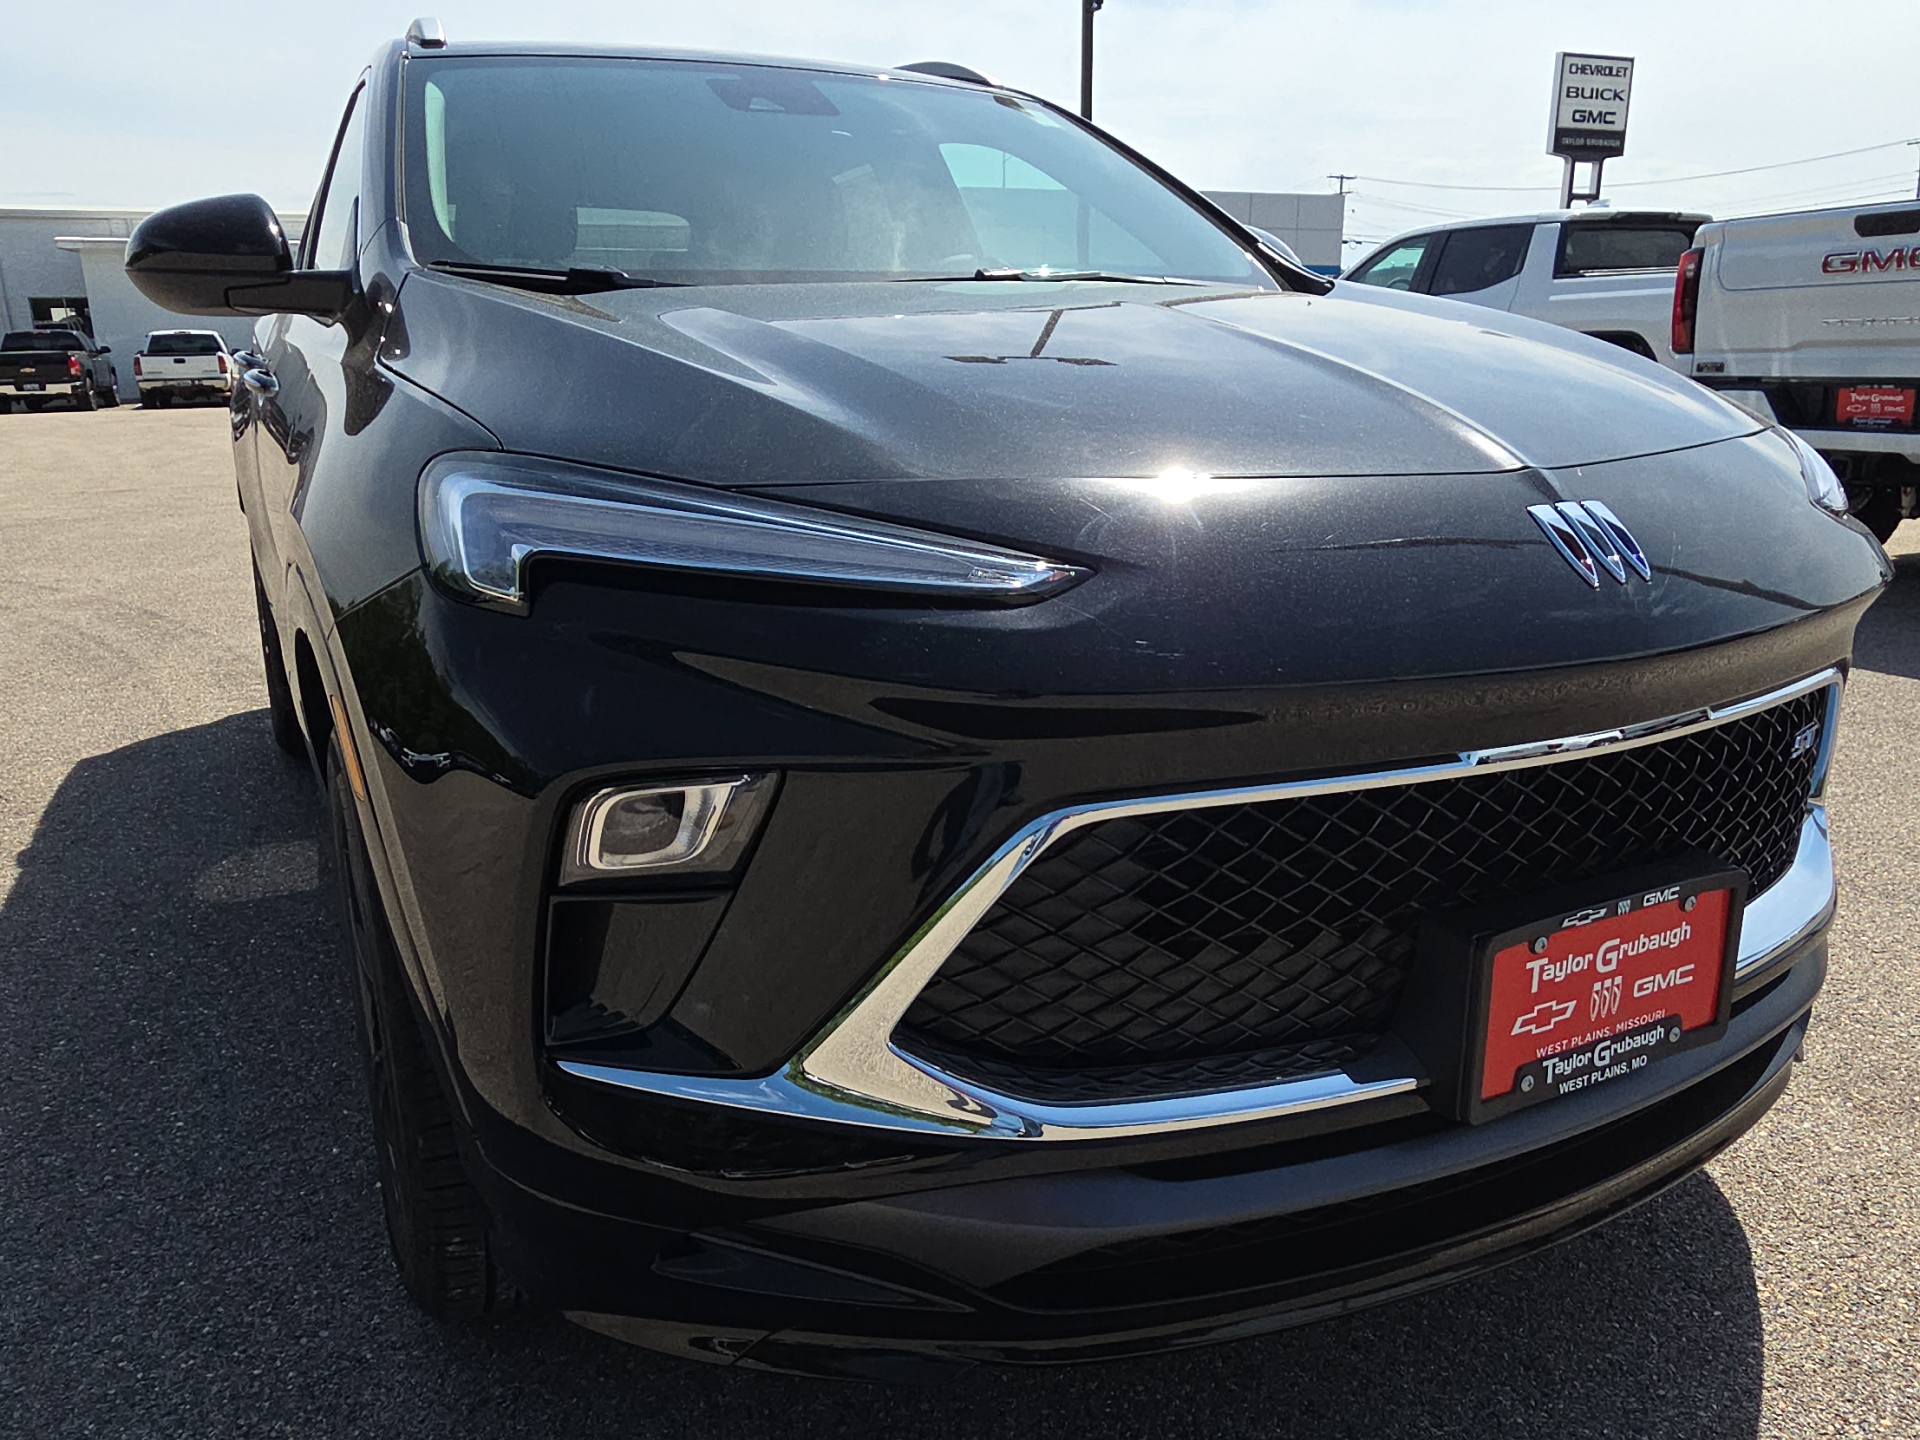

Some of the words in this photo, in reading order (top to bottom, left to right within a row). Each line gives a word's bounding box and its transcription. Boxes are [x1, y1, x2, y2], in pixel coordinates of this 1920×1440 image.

[1569, 63, 1628, 78] CHEVROLET
[1566, 86, 1625, 101] BUICK
[1572, 109, 1617, 124] GMC
[1643, 886, 1680, 907] GMC
[1526, 953, 1593, 993] Taylor
[1596, 921, 1691, 973] Grubaugh
[1633, 964, 1695, 997] GMC
[1536, 1040, 1568, 1058] WEST
[1615, 1009, 1665, 1034] MISSOURI
[1543, 1051, 1592, 1084] Taylor
[1594, 1025, 1665, 1067] Grubaugh
[1559, 1074, 1590, 1094] WEST
[1591, 1062, 1630, 1084] PLAINS,
[1631, 1055, 1648, 1070] MO
